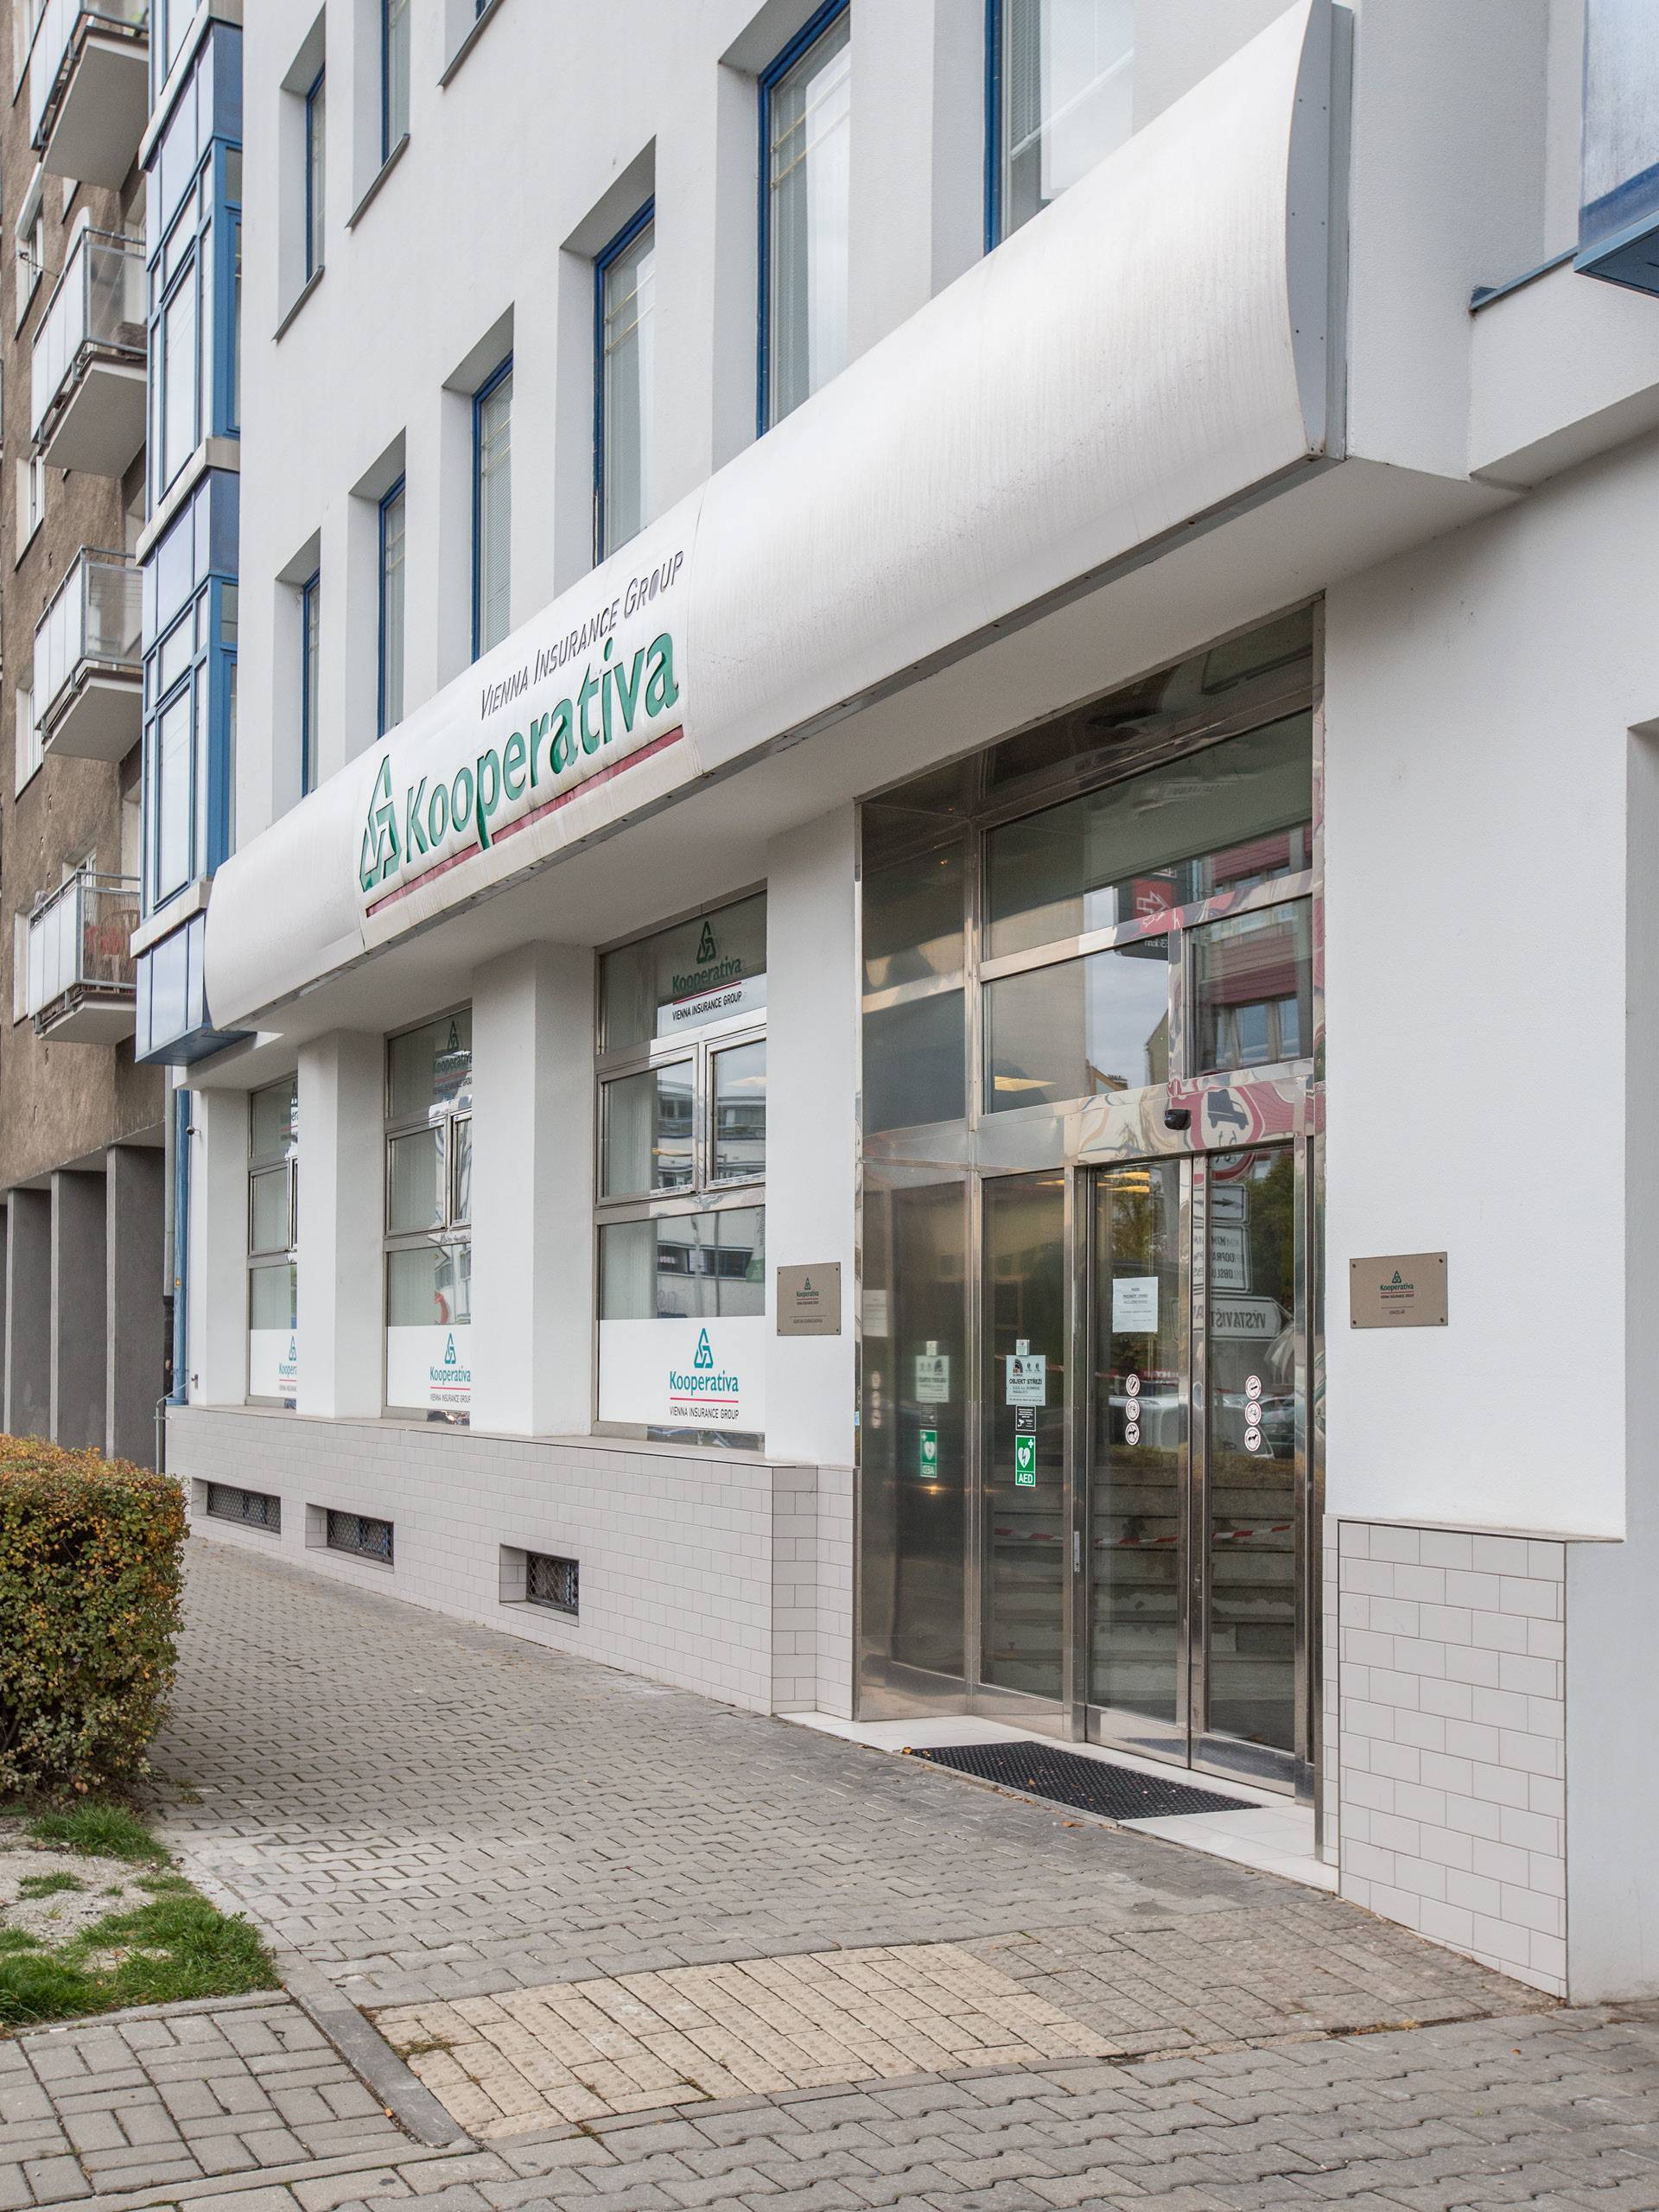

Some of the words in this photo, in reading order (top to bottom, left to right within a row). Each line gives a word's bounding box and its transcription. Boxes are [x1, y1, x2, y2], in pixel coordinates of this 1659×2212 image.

[481, 665, 528, 720] VIENNA
[533, 598, 620, 685] INSURANCE
[624, 550, 684, 620] GROUP
[406, 632, 680, 864] Kooperativa
[672, 955, 742, 994] Kooperativa
[672, 1007, 691, 1021] VIENNA
[692, 996, 722, 1015] INSURANCE
[723, 990, 742, 1006] GROUP
[429, 1364, 471, 1386] Kooperativa
[670, 1370, 739, 1396] Kooperativa
[670, 1406, 689, 1417] VIENNA
[689, 1407, 719, 1419] INSURANCE
[720, 1408, 739, 1420] GROUP
[1018, 1472, 1033, 1484] AED
